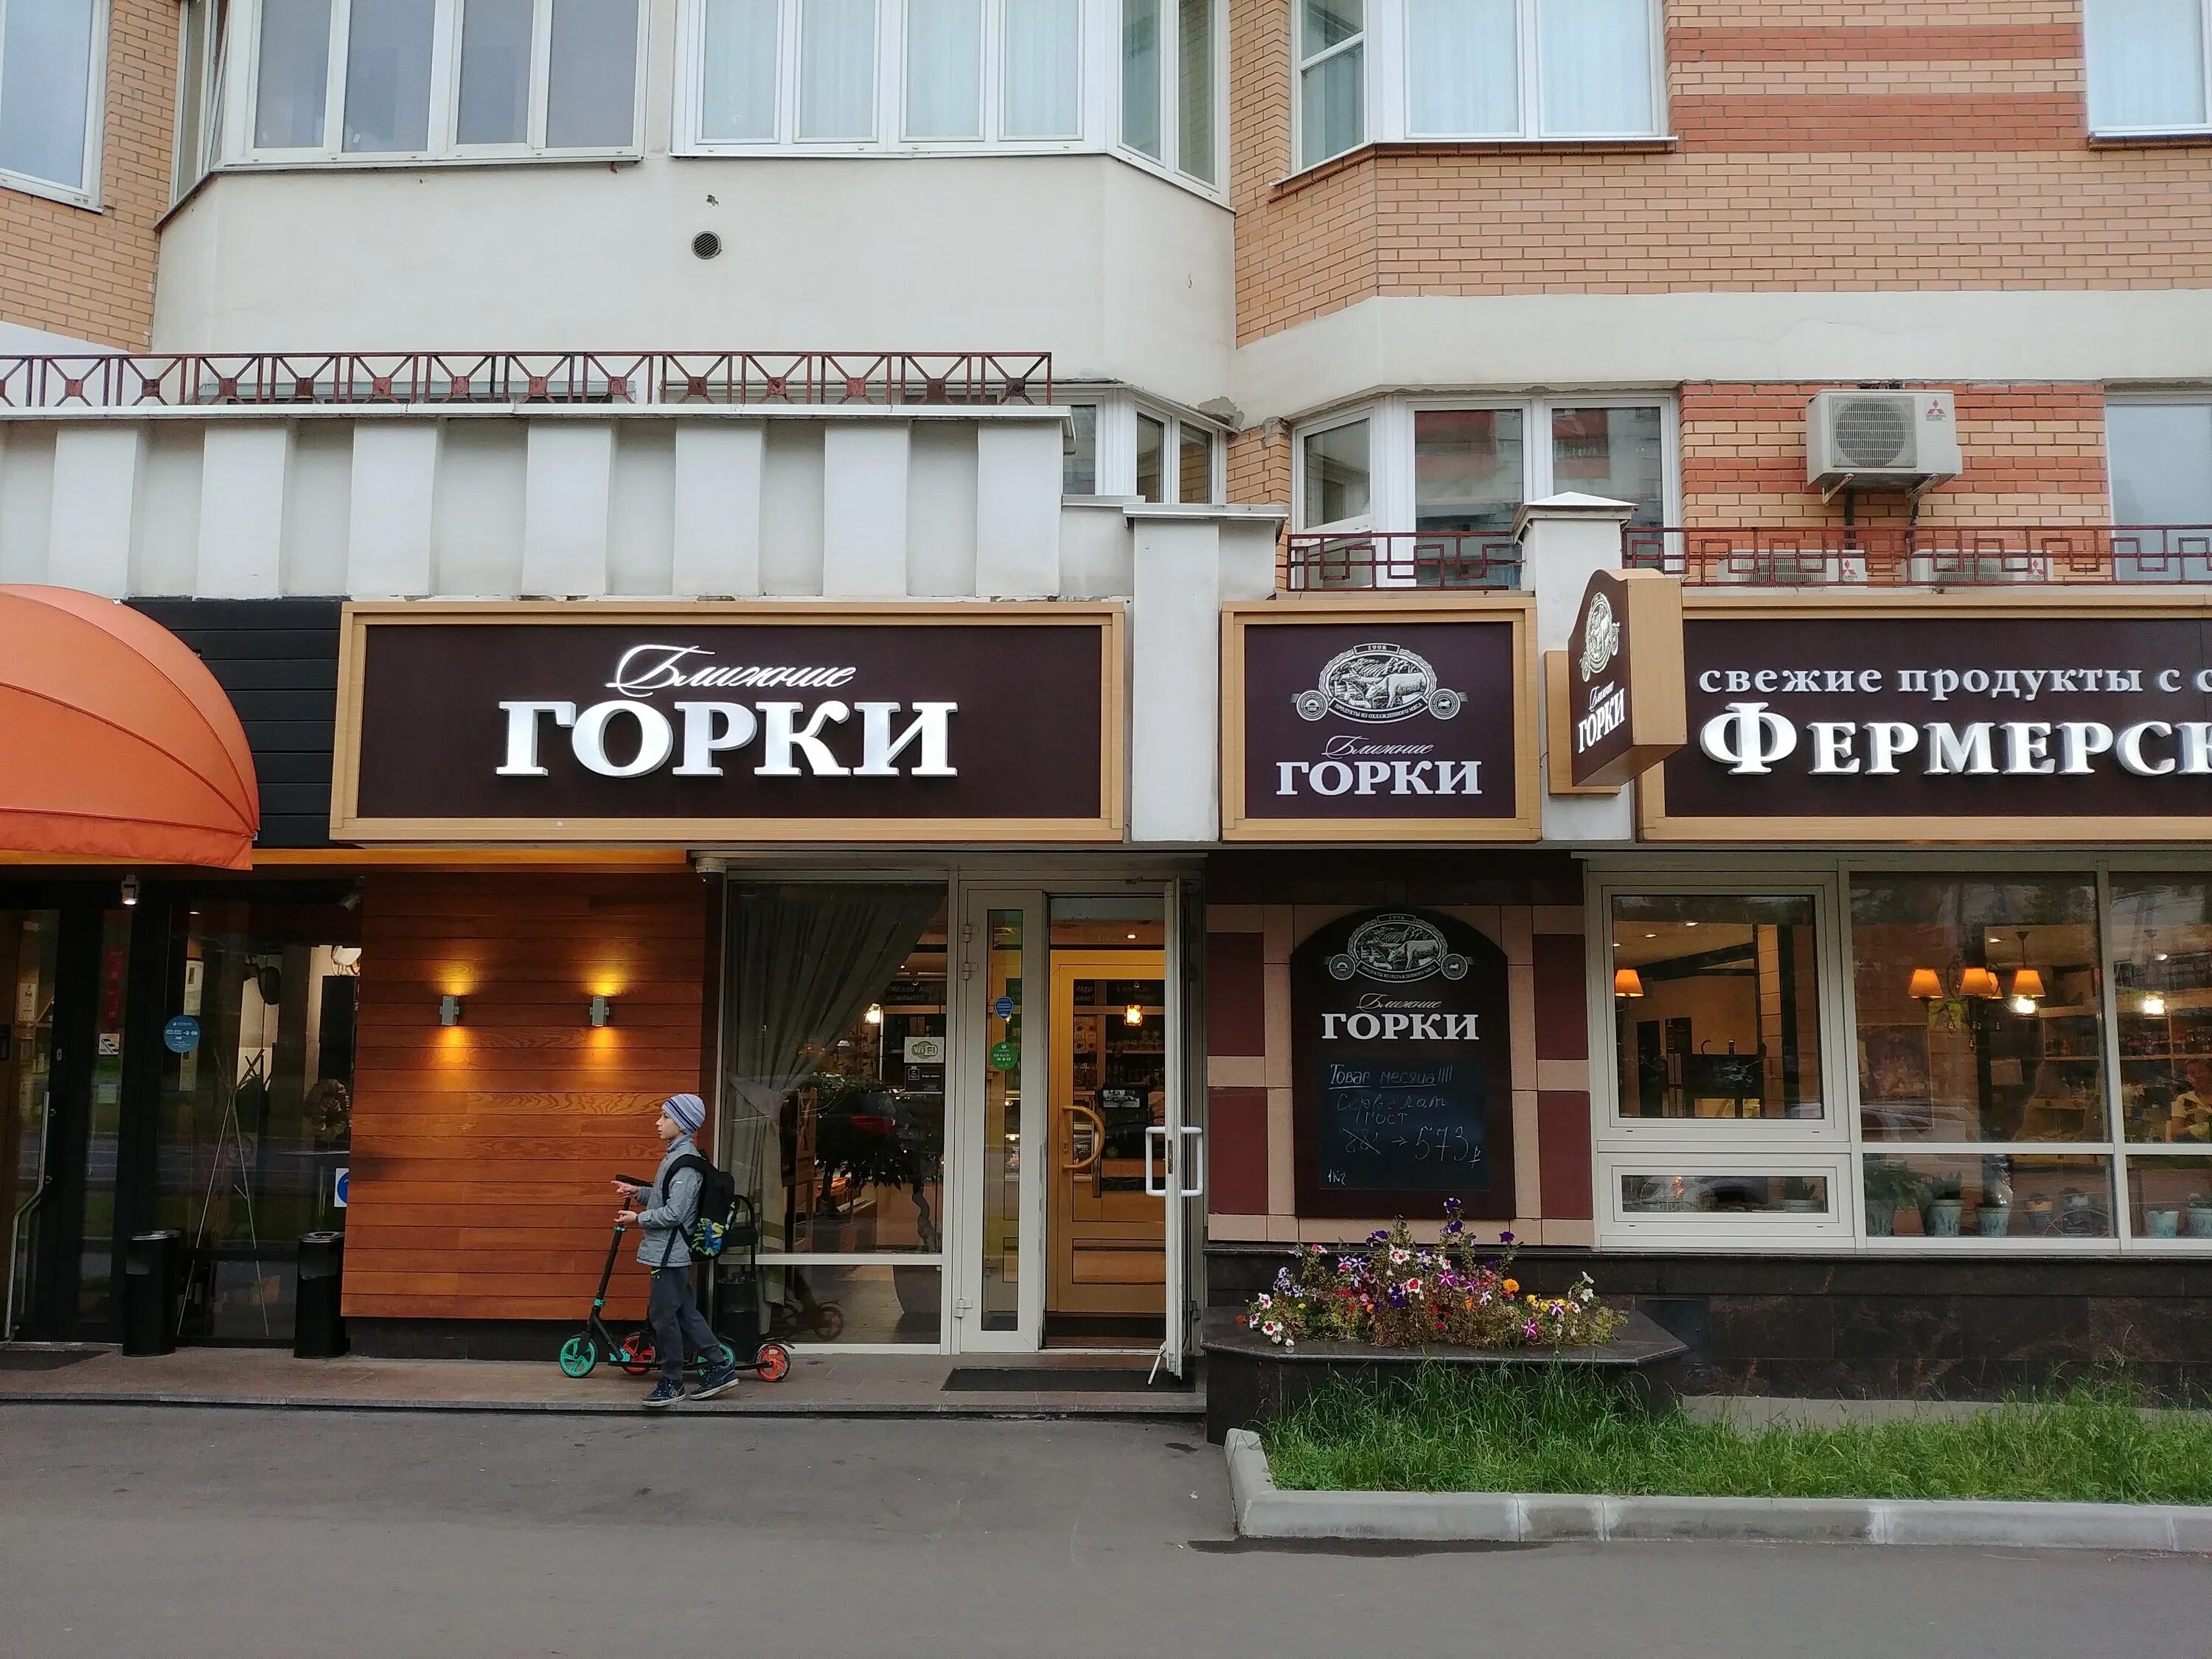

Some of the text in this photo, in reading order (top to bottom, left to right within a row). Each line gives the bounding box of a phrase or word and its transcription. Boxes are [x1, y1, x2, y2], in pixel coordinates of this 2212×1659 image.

[605, 644, 857, 698] Ближние
[1699, 668, 1883, 693] свежие
[1898, 667, 2143, 700] продукты
[2159, 669, 2183, 692] с
[1334, 703, 1361, 717] ПРОДУКТЫ
[1578, 687, 1625, 754] ГОРКИ
[494, 699, 958, 778] ГОРКИ
[1321, 735, 1435, 759] Ближние
[1276, 760, 1483, 796] ГОРКИ
[1356, 992, 1442, 1013] Ближние
[1321, 1012, 1480, 1040] ГОРКИ
[1330, 1064, 1371, 1085] Товар
